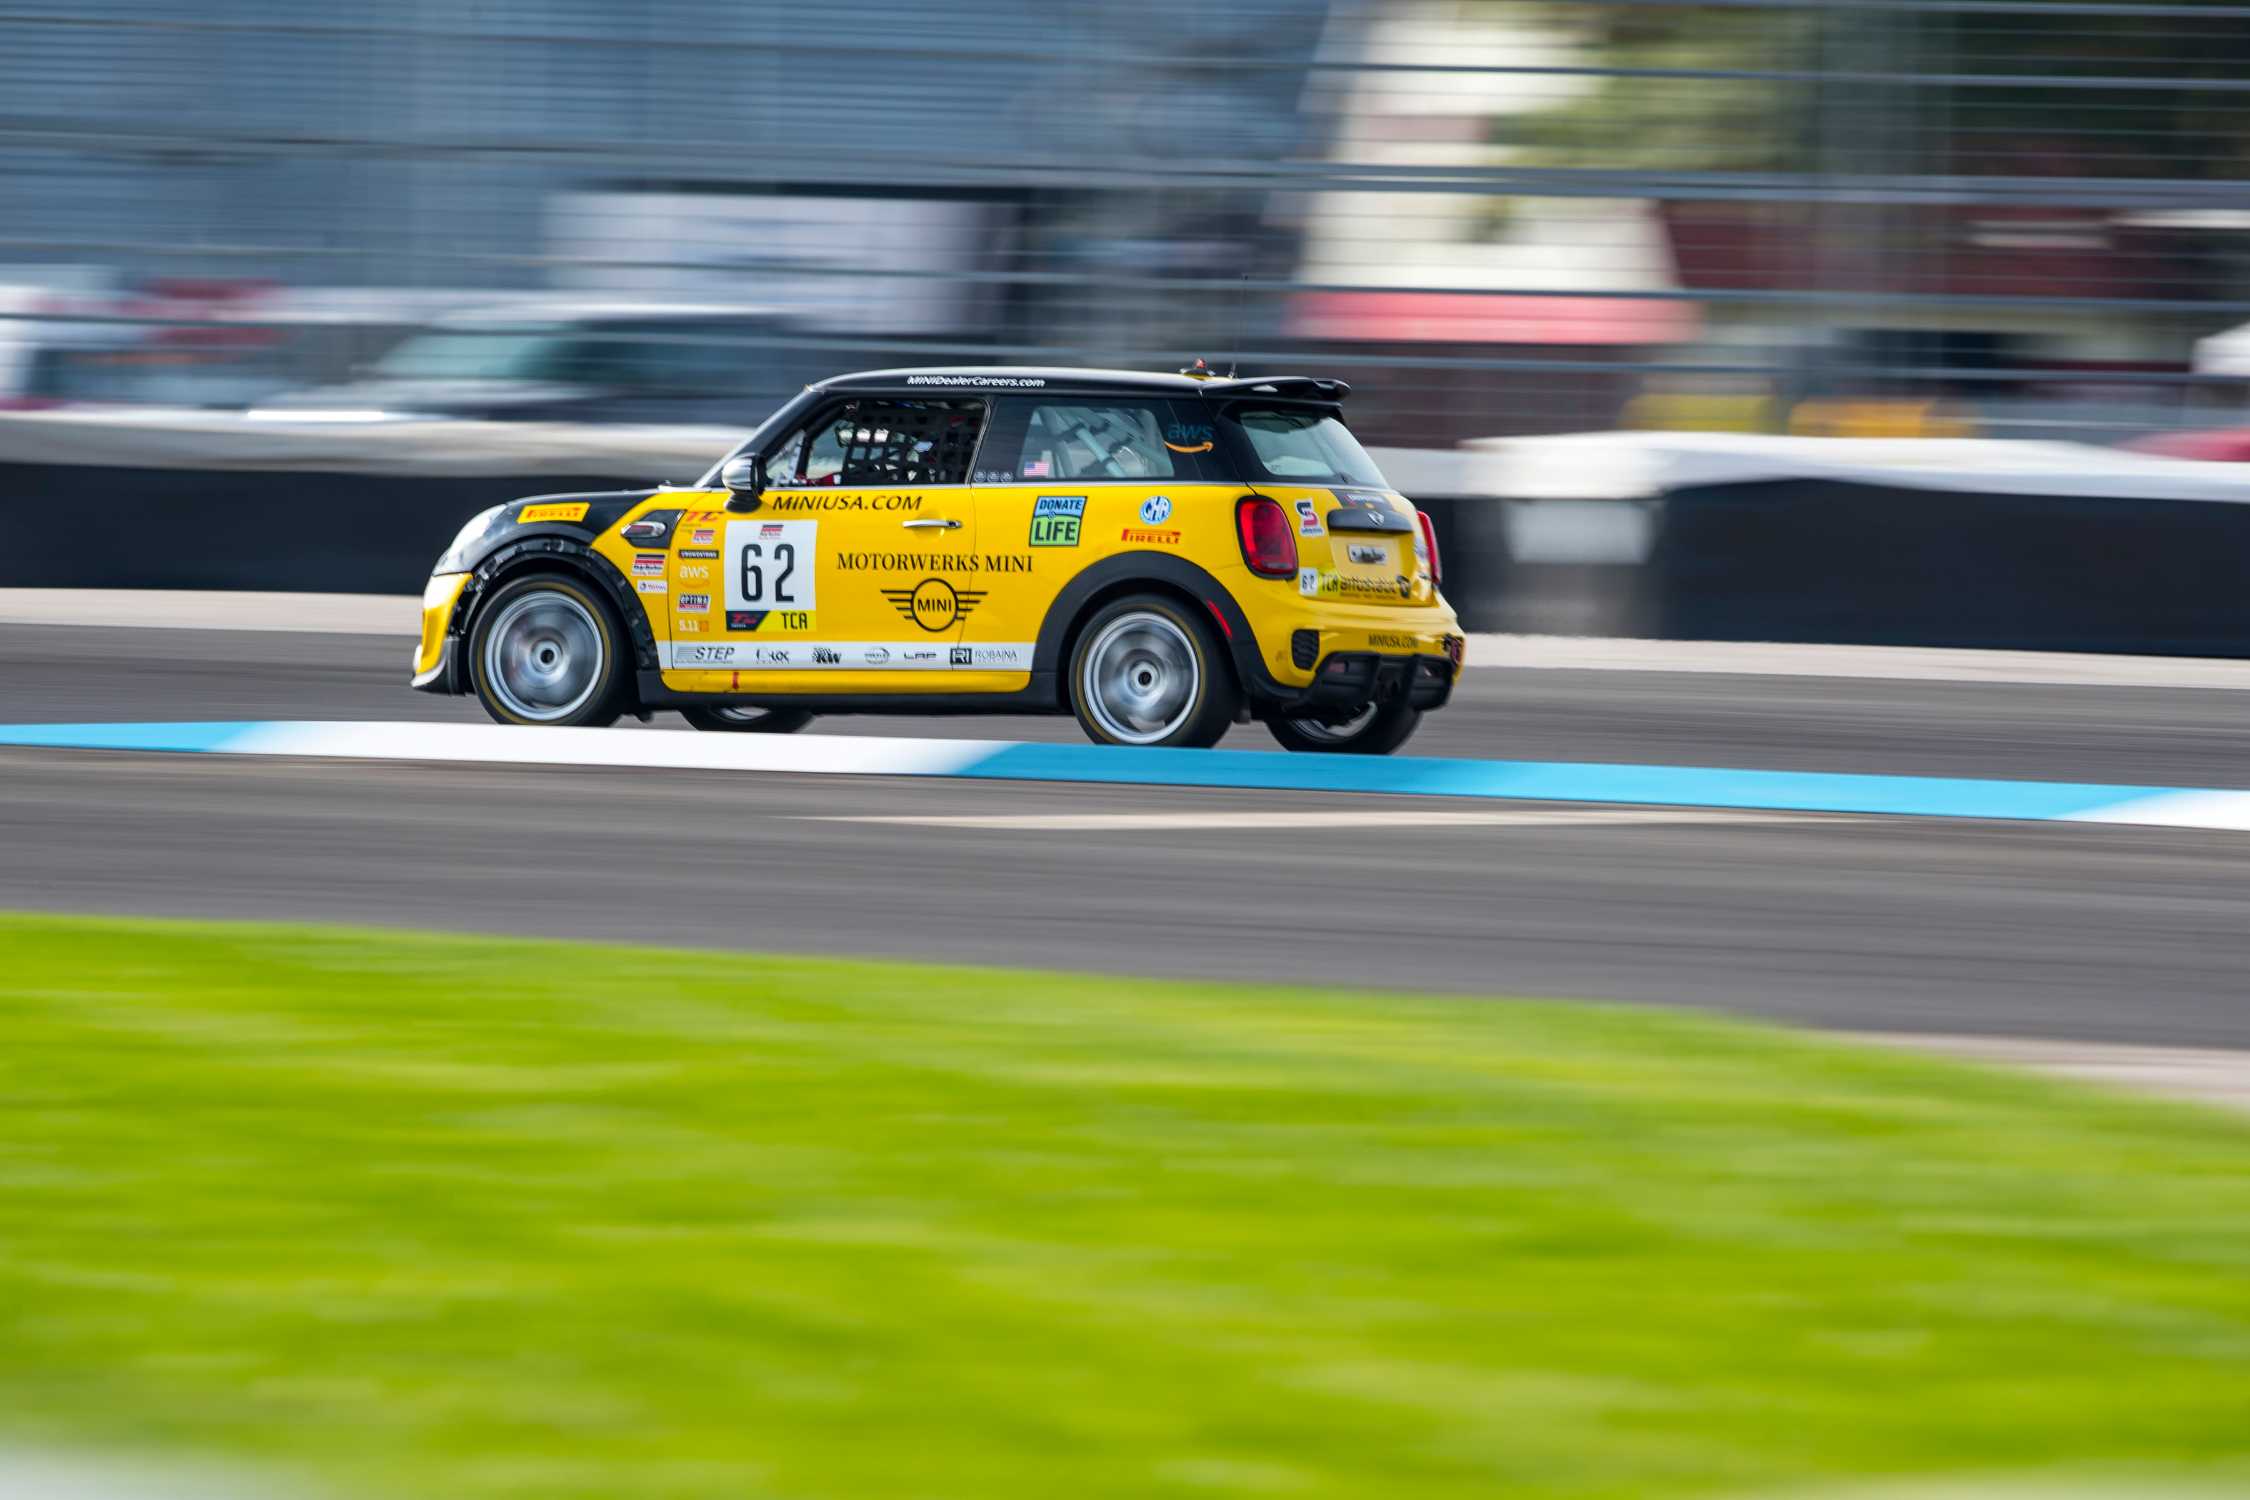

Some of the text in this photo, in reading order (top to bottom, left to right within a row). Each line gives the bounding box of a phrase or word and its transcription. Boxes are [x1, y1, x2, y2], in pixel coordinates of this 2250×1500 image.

[1167, 423, 1214, 440] aws
[772, 496, 923, 511] MINIUSA.COM
[1039, 499, 1082, 511] DONATE
[1034, 521, 1077, 542] LIFE
[1121, 529, 1181, 544] PIRELLI
[837, 552, 1034, 572] MOTORWERKS MINI
[680, 565, 709, 579] aws
[741, 544, 795, 603] 62
[917, 600, 952, 612] MINI
[781, 613, 808, 630] TCA
[695, 647, 735, 660] STEP
